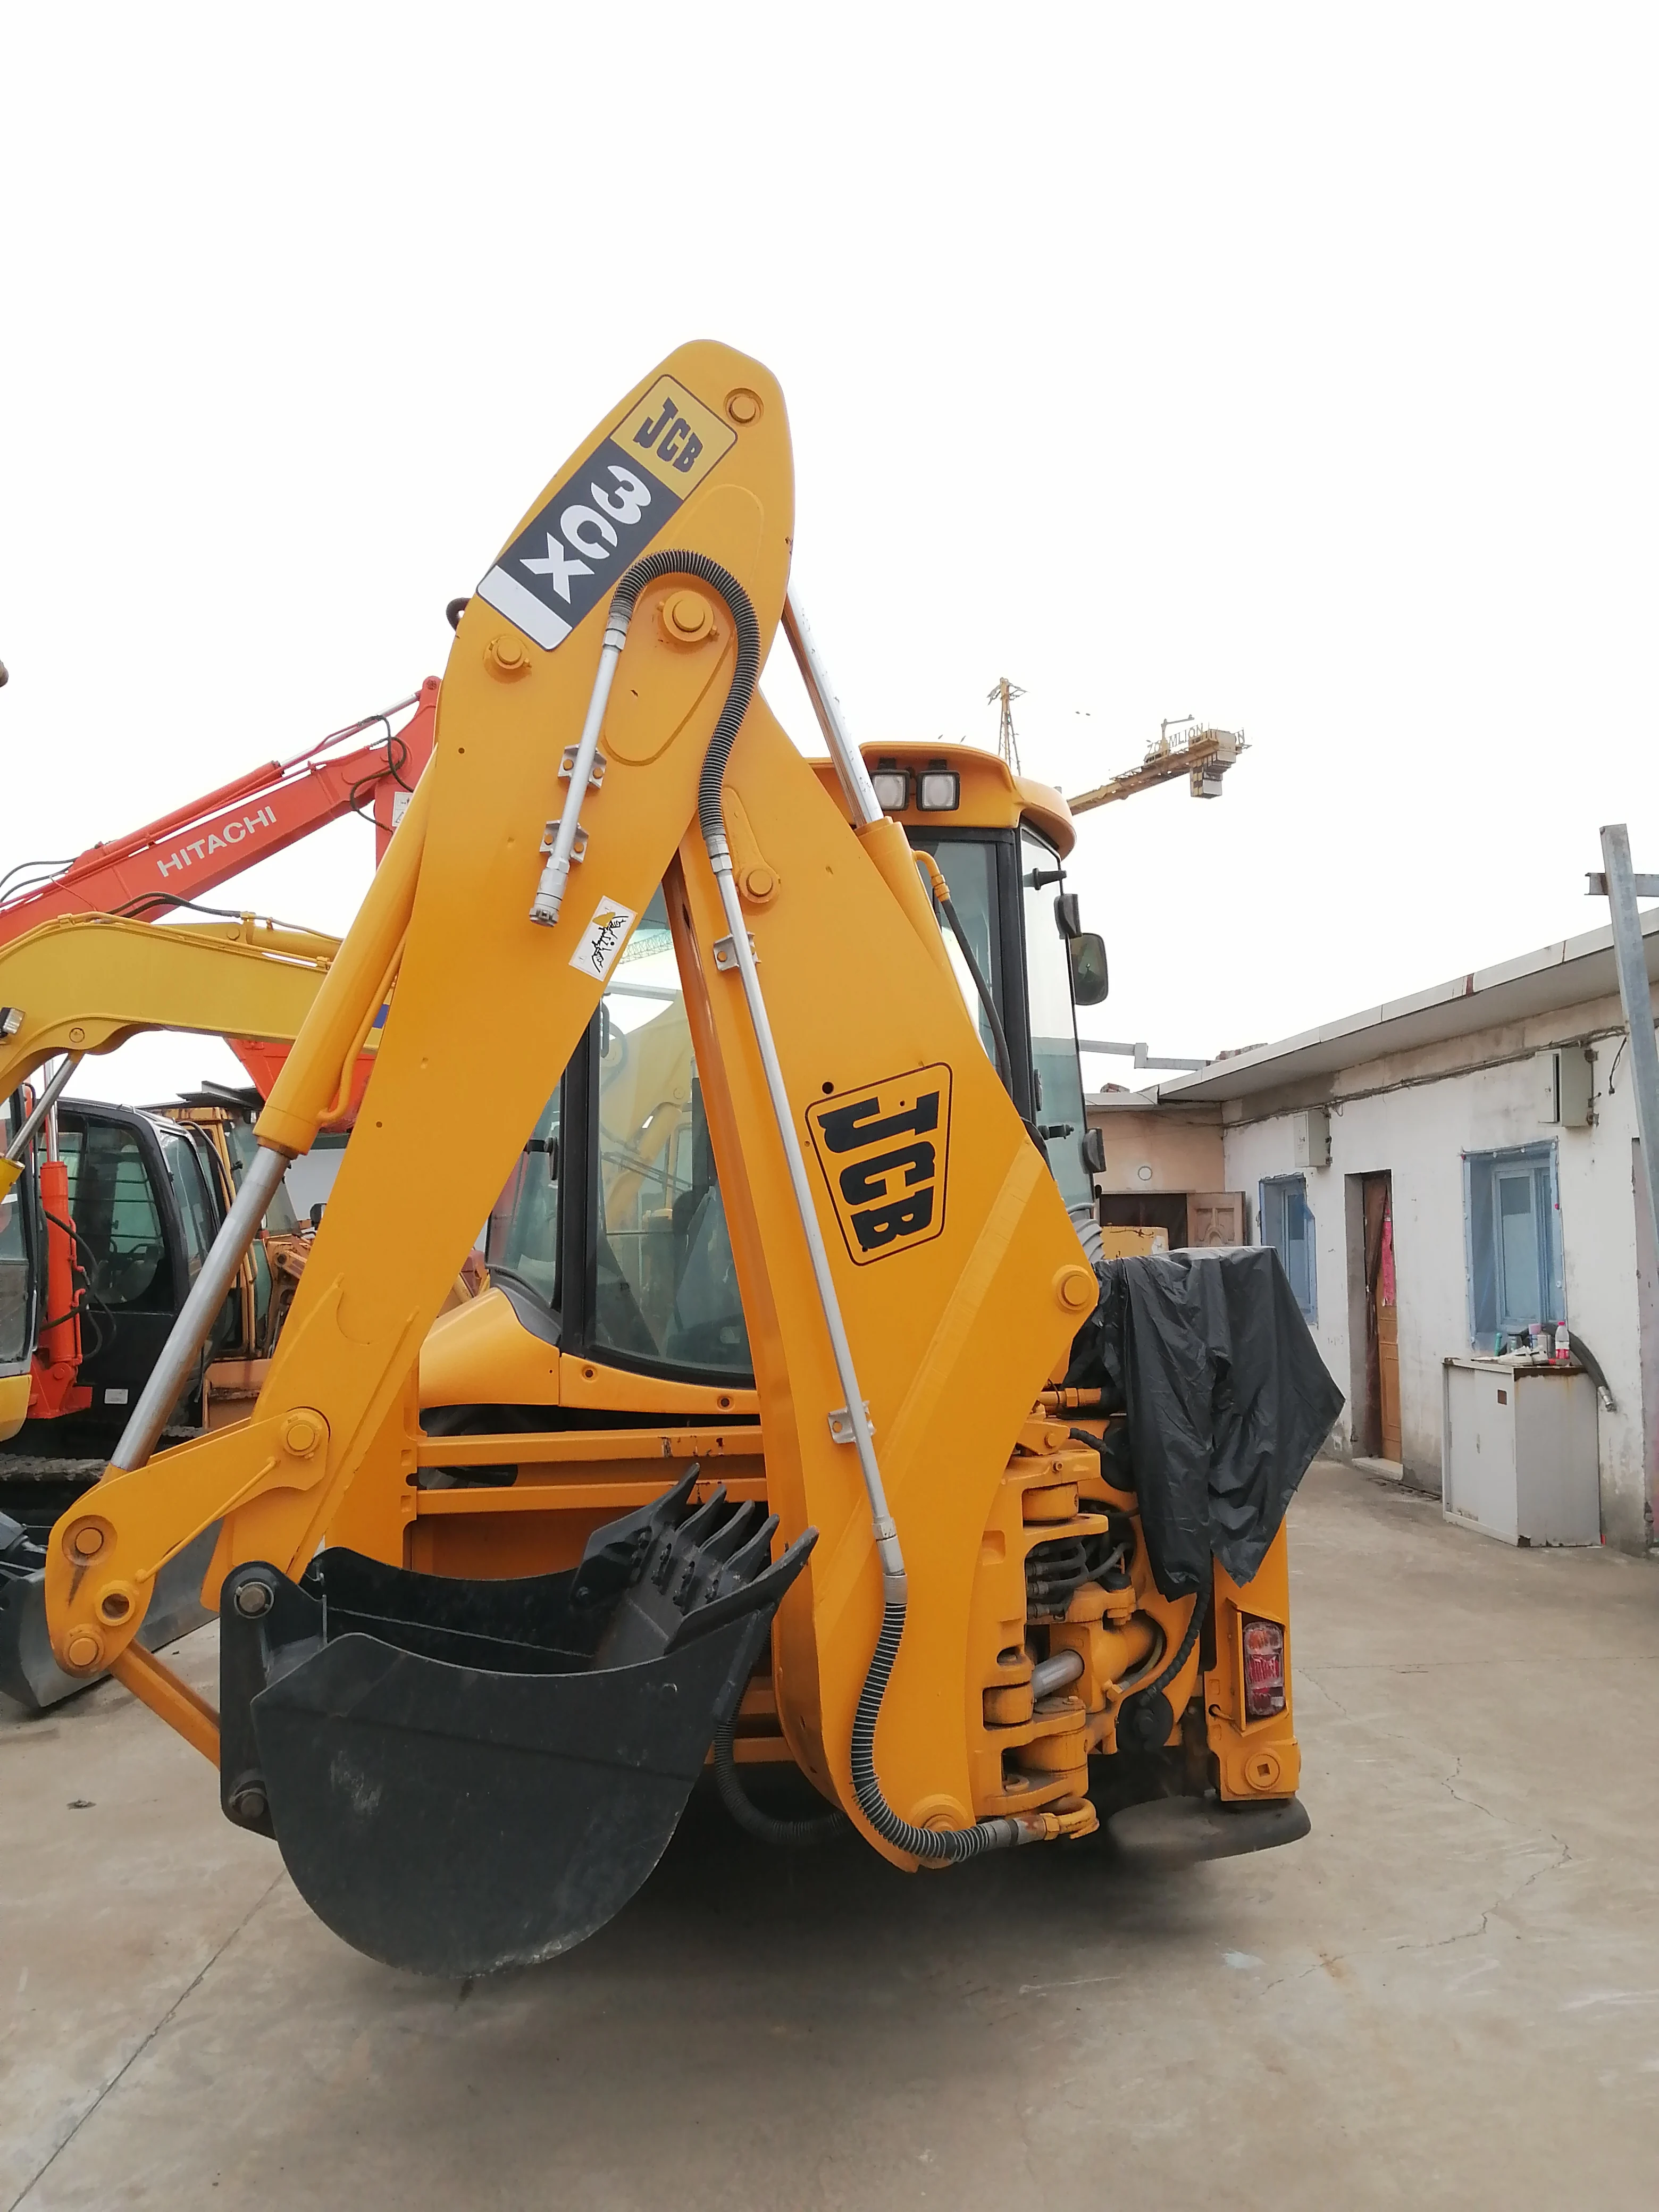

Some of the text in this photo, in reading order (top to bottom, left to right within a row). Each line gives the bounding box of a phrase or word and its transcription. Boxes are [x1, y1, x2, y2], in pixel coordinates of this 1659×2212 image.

[632, 396, 703, 473] JCB
[519, 465, 652, 605] 3CX
[1147, 723, 1203, 754] ZOMLION
[157, 806, 277, 877] HITACHI
[816, 1090, 940, 1250] JCB
